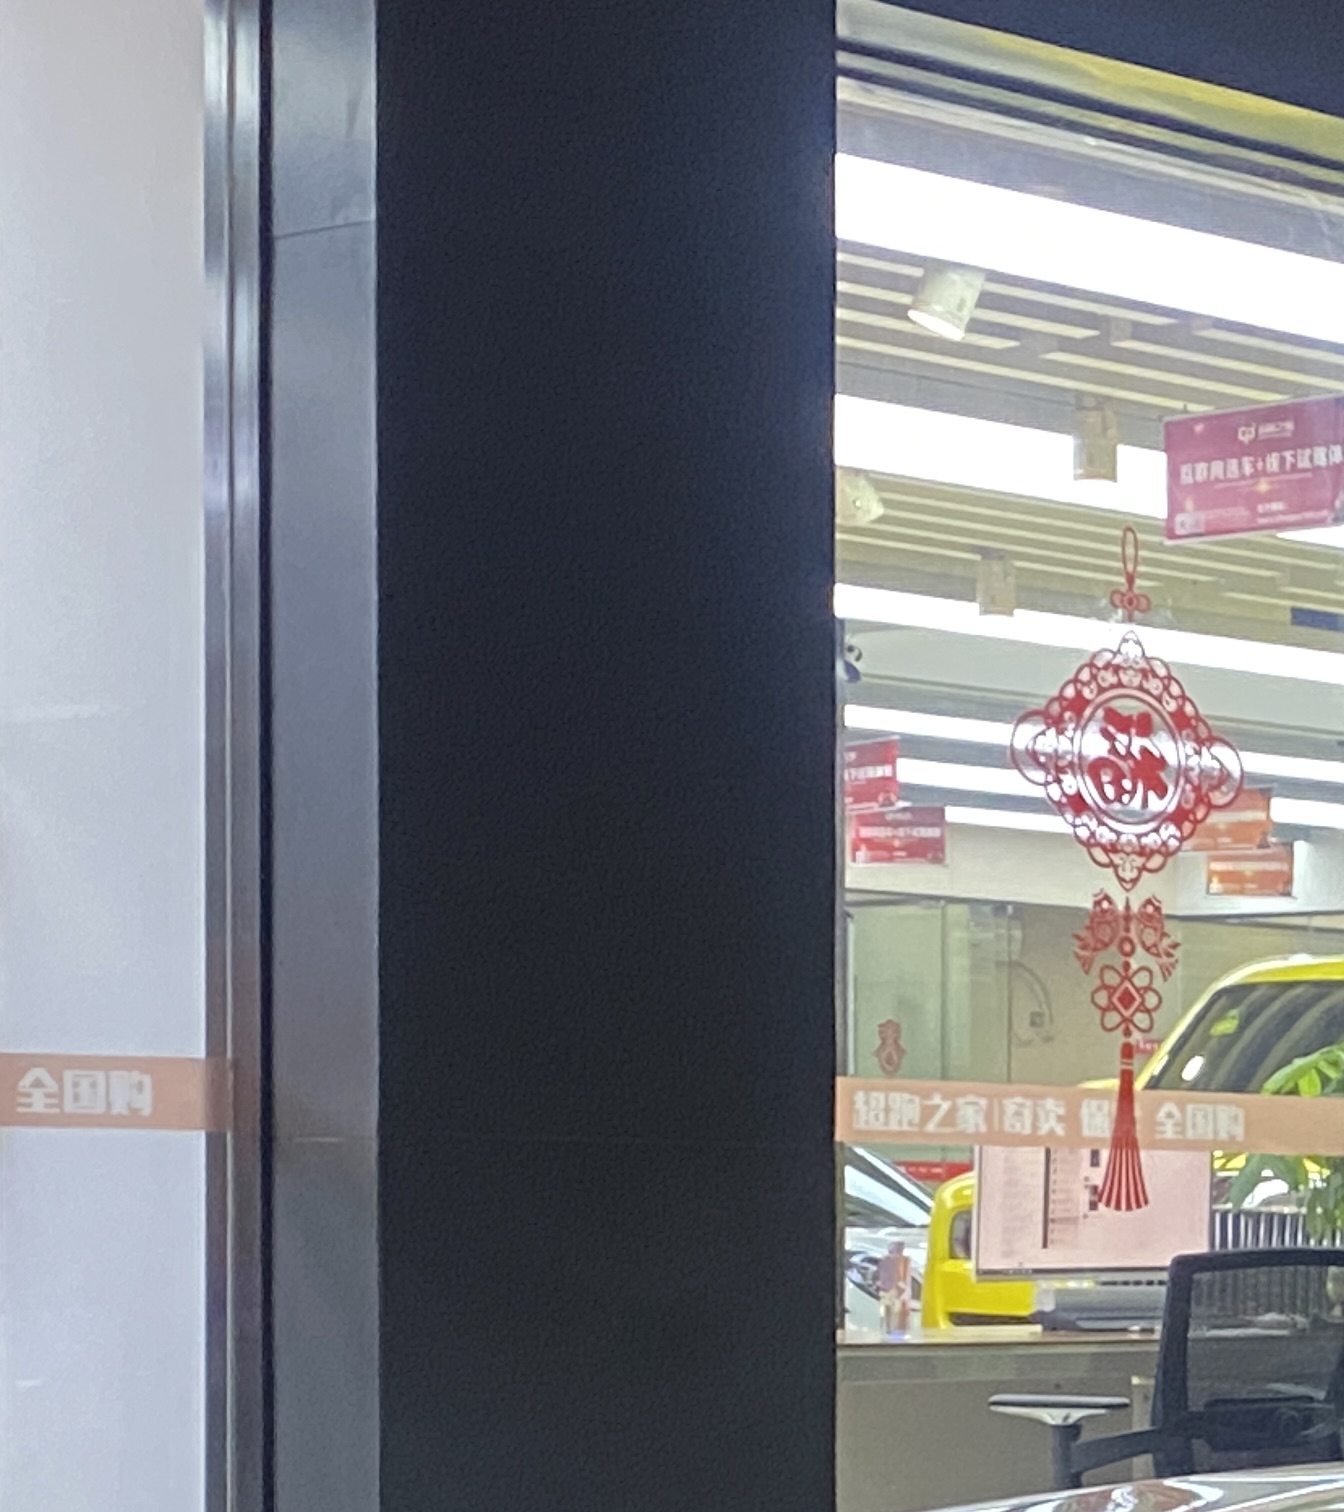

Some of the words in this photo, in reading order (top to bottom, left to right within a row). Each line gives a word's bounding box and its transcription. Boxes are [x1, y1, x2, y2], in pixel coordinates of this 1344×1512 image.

[16, 1066, 154, 1118] 全国购
[1154, 1101, 1245, 1142] 全国购
